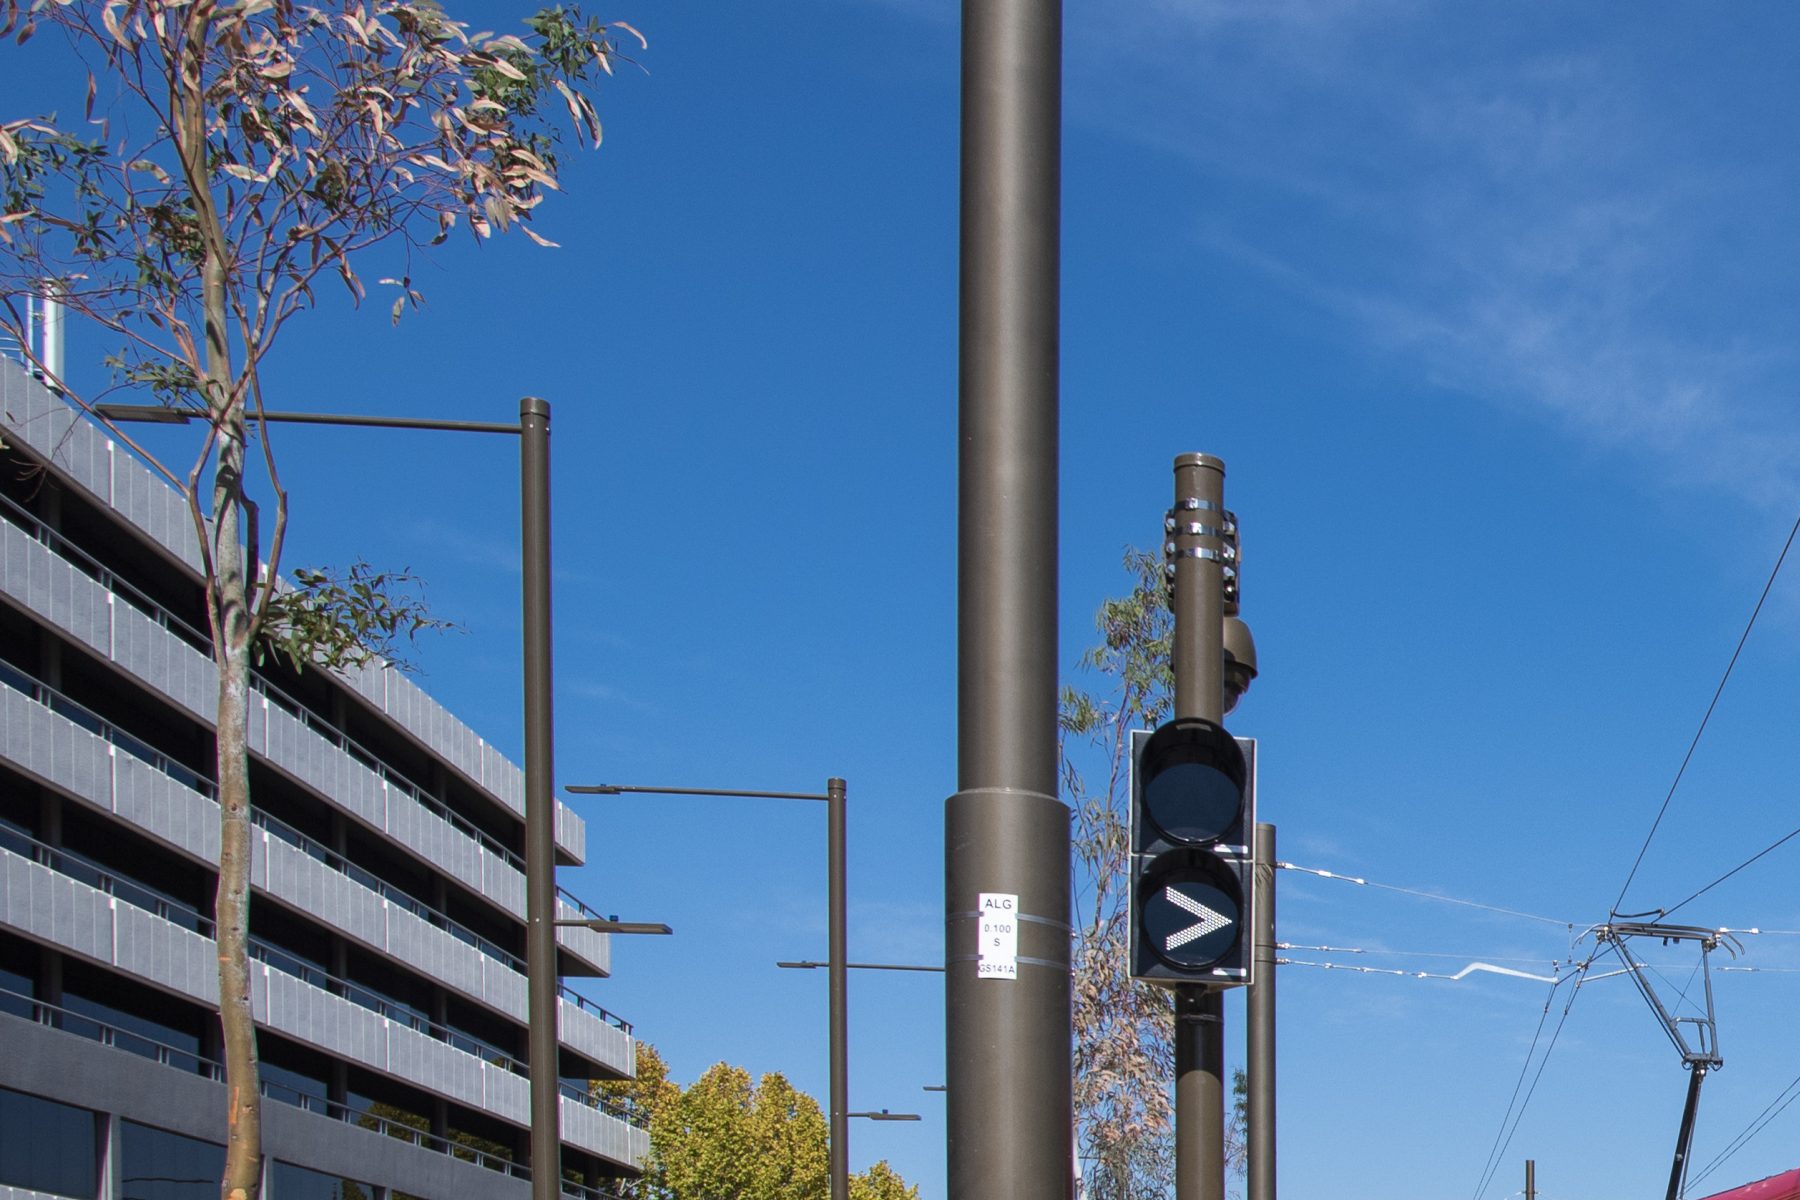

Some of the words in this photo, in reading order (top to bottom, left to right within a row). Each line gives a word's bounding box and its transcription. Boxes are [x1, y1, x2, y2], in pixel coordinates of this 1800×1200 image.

[985, 898, 1012, 910] ALG
[984, 924, 1011, 934] 0.100
[993, 937, 1001, 947] S
[979, 964, 1015, 973] GS141A
